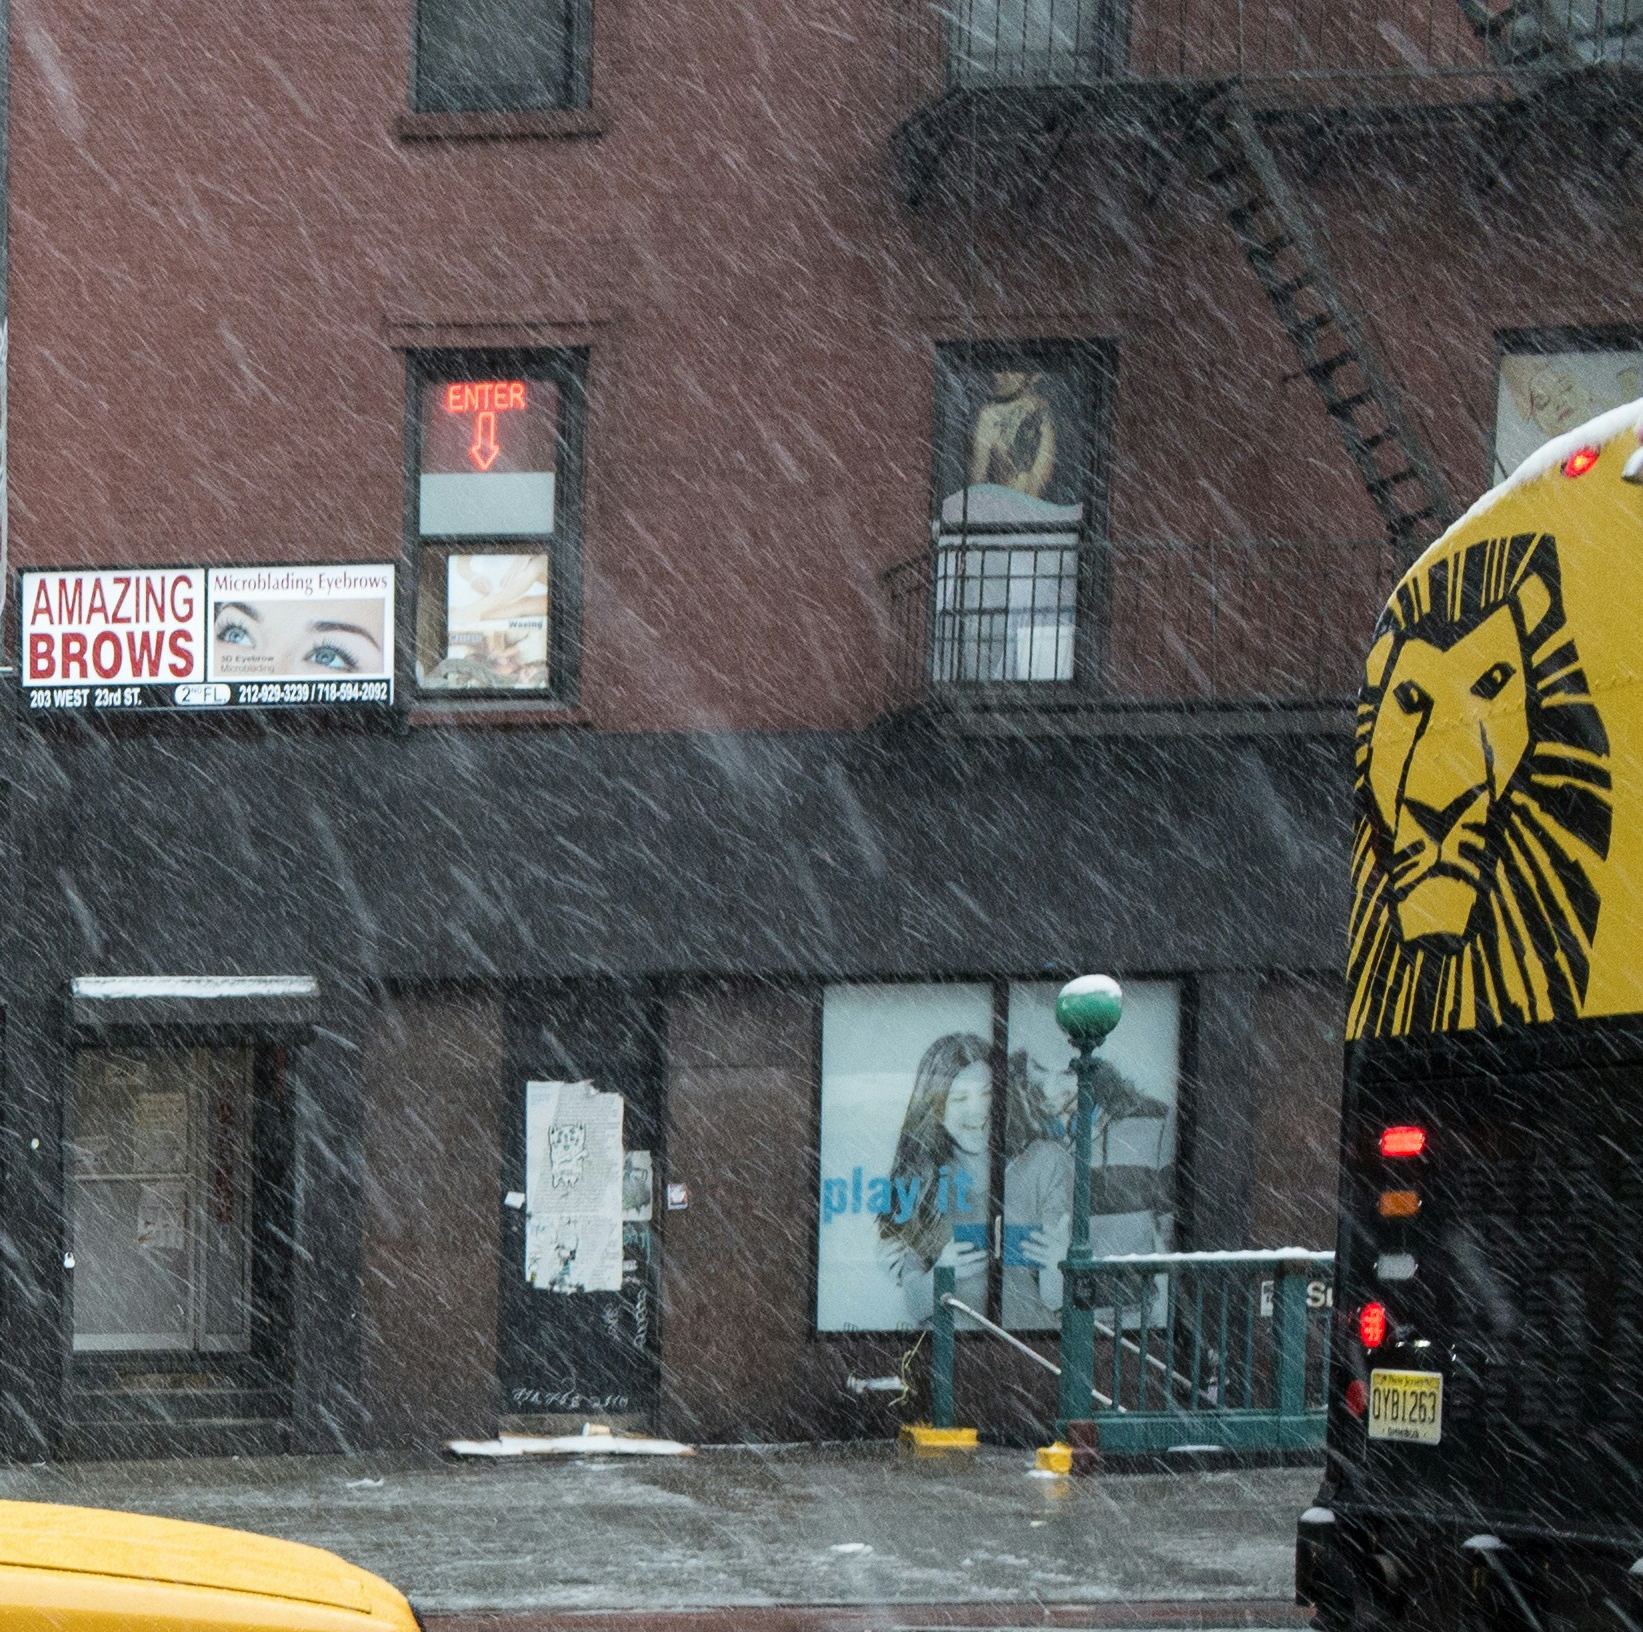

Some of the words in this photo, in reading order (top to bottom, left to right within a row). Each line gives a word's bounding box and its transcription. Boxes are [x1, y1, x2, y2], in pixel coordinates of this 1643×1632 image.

[447, 382, 525, 411] ENTER
[214, 572, 313, 595] Microblading
[318, 571, 388, 595] Eyebrows
[30, 575, 194, 625] AMAZING
[29, 629, 194, 680] BROWS
[235, 654, 275, 664] Eyebrow
[30, 689, 51, 708] 203
[54, 689, 90, 707] WEST
[95, 687, 121, 707] 23rd
[123, 687, 142, 706] ST.
[238, 683, 309, 704] 212-929-3239
[317, 682, 388, 702] 718-594-2092
[822, 1166, 921, 1225] play
[937, 1164, 974, 1214] it
